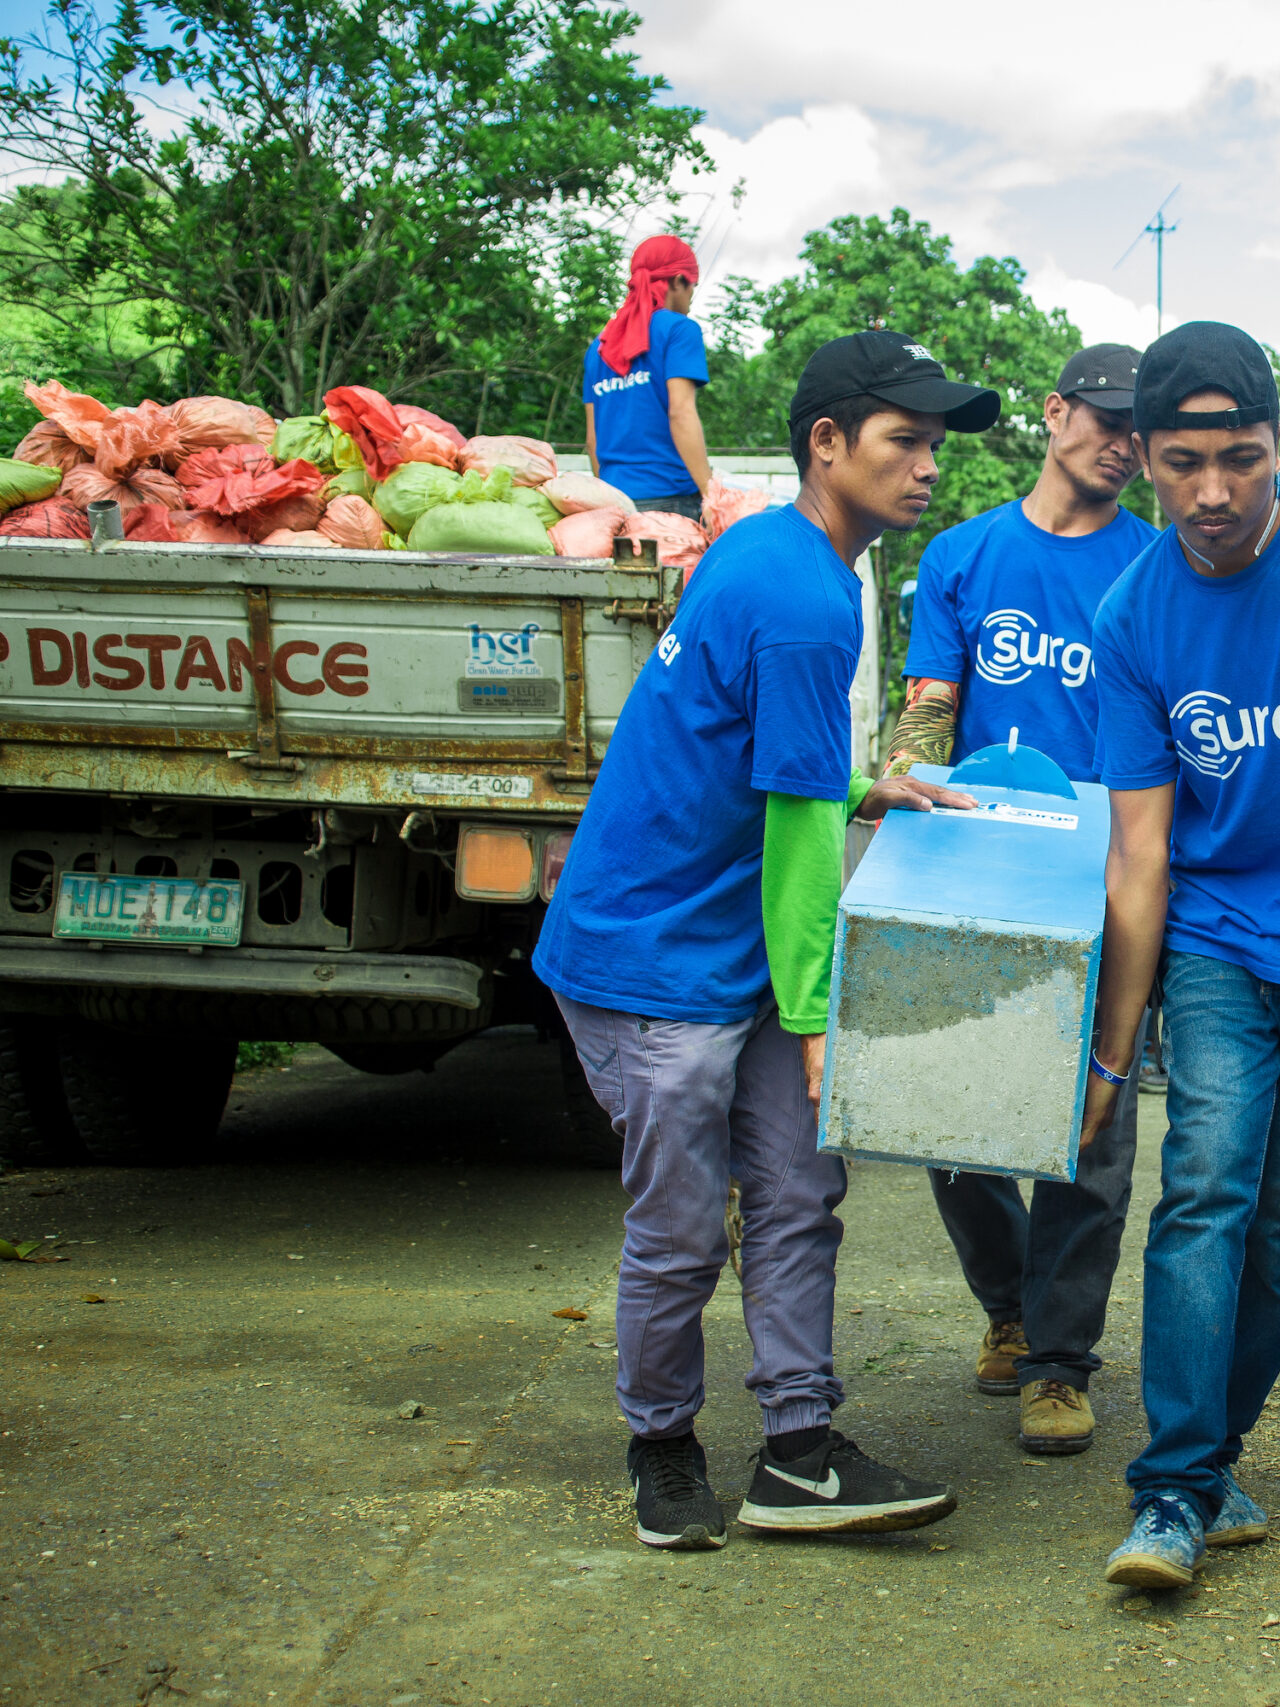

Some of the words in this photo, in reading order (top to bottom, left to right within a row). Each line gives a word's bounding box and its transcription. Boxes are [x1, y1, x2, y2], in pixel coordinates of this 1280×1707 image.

[26, 627, 369, 696] DISTANCE
[992, 629, 1096, 688] surg
[165, 884, 229, 923] 148
